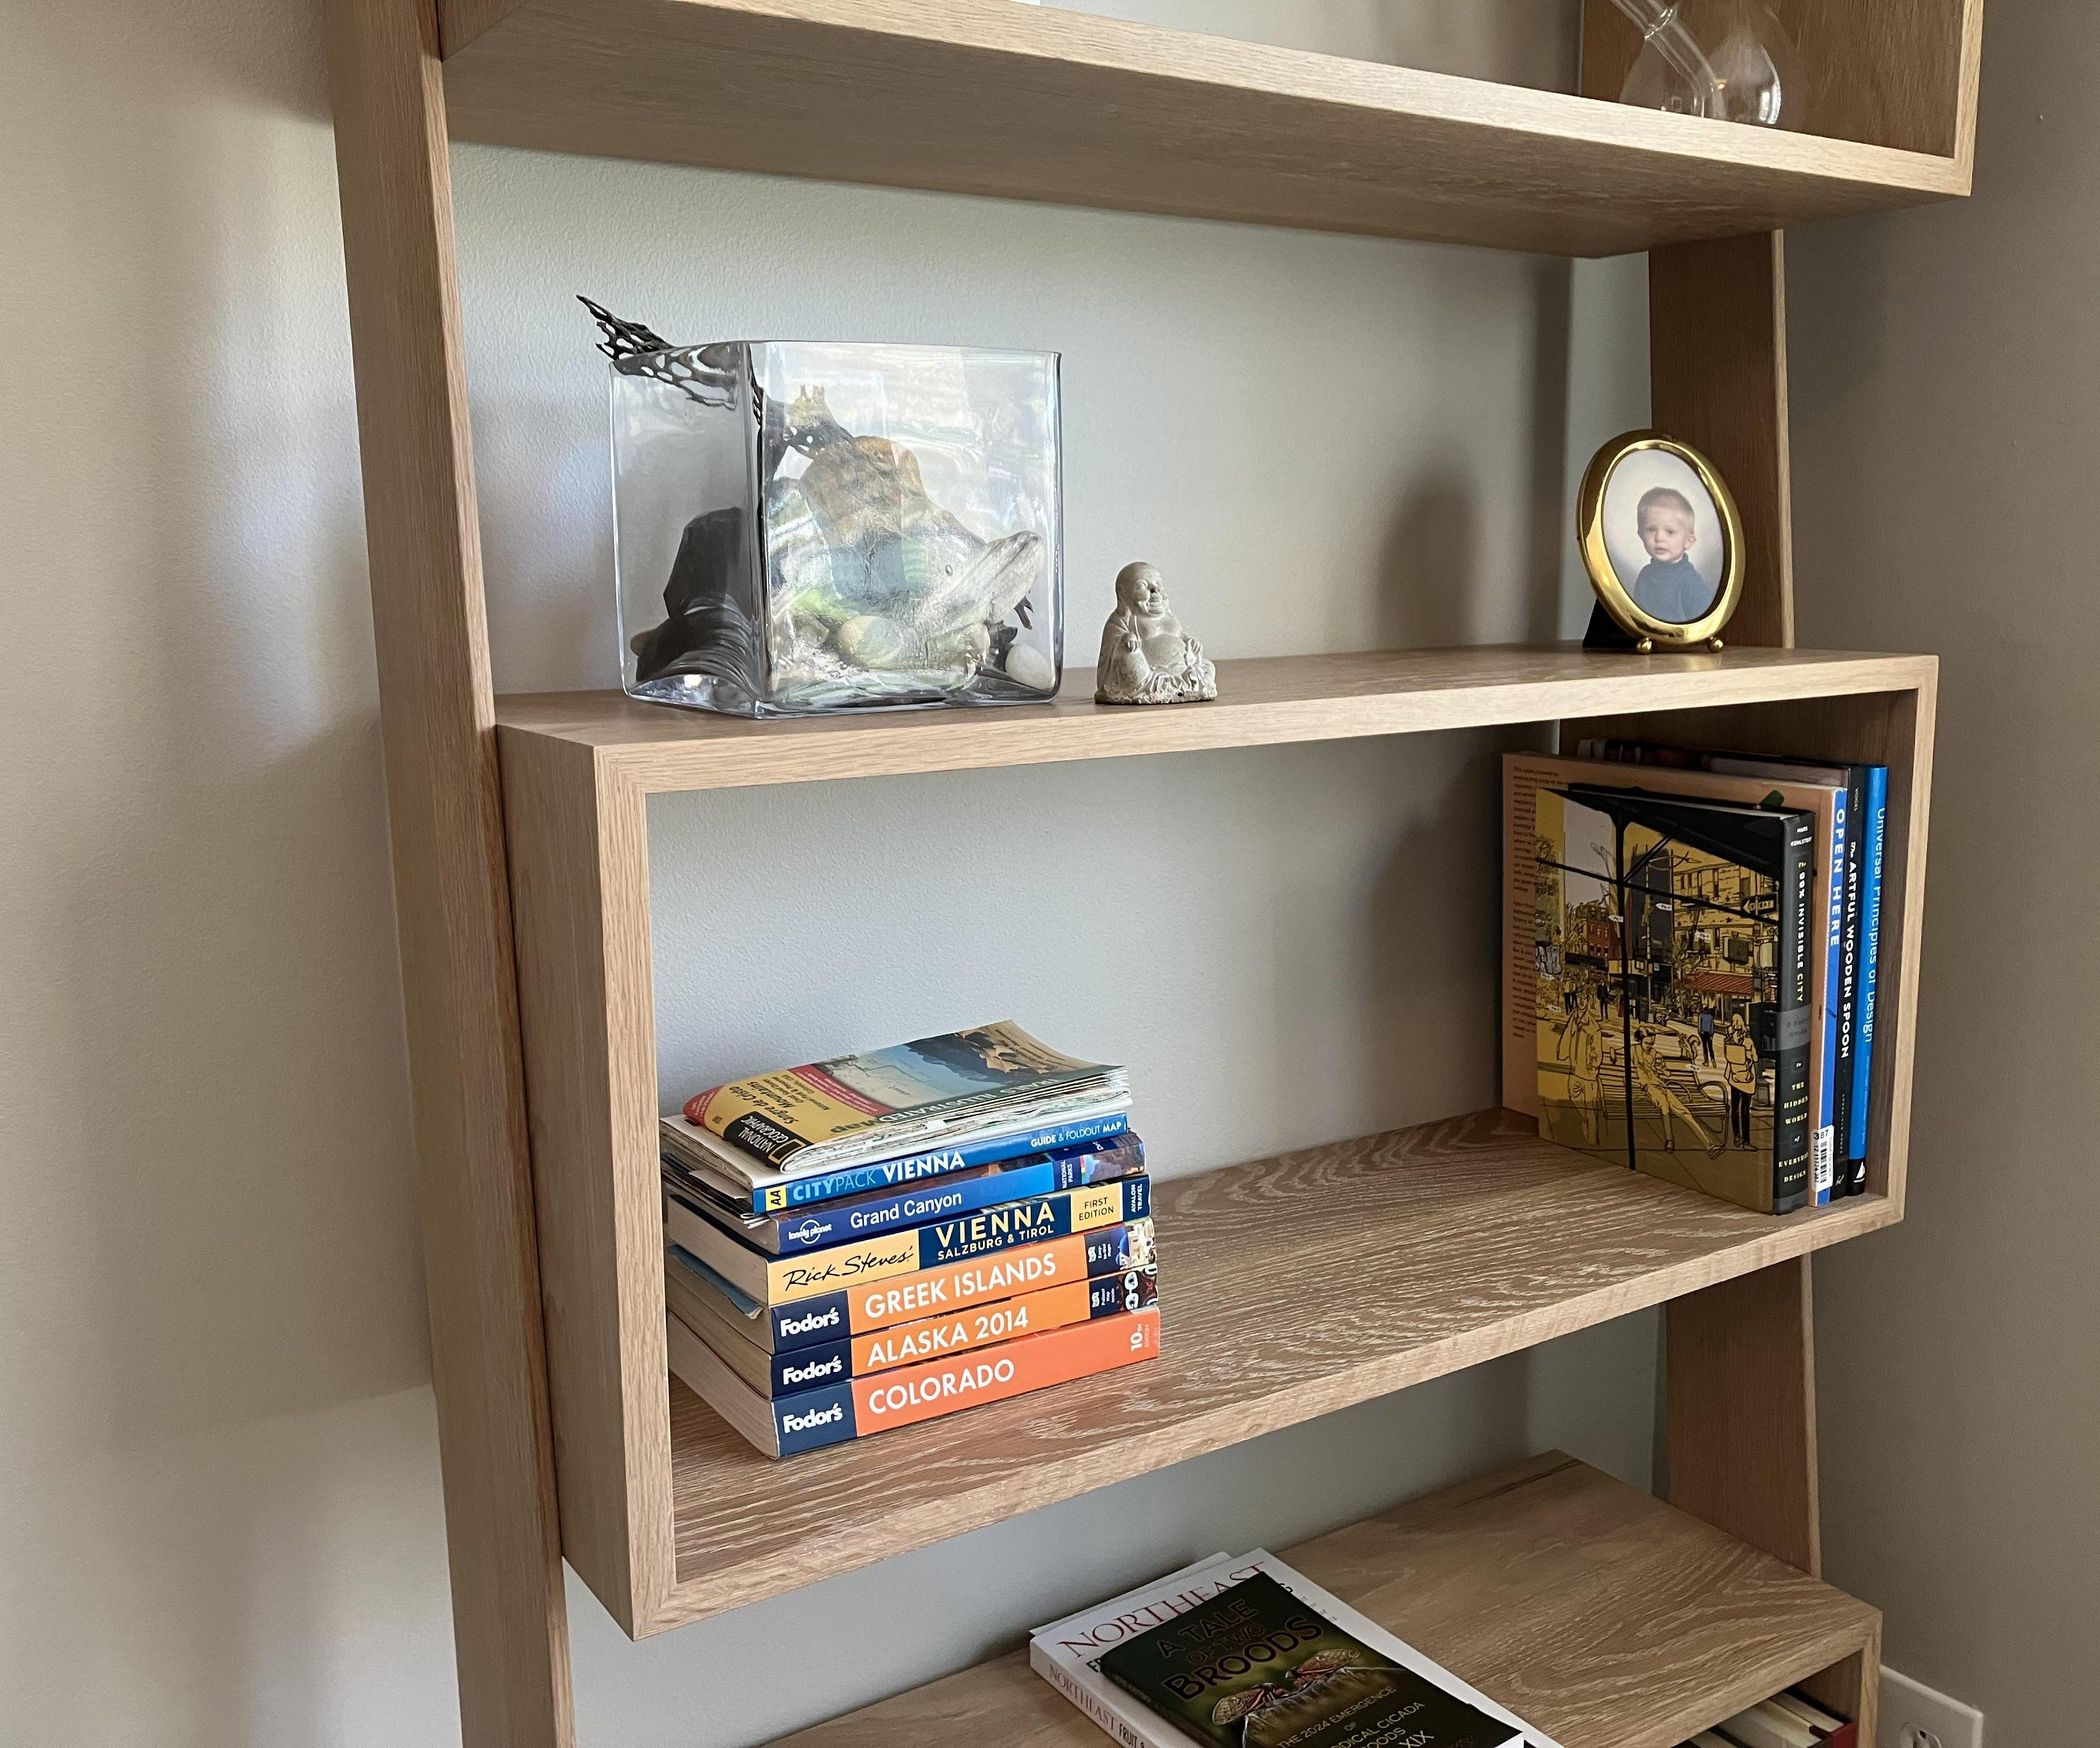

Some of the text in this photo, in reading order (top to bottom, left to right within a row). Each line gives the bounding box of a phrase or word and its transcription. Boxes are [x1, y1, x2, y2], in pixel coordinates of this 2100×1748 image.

[1874, 808, 1885, 879] Universal
[1830, 808, 1845, 946] OPEN HERE
[1847, 861, 1857, 922] ARTFUL
[1796, 902, 1805, 969] INVISIBLE
[1869, 886, 1881, 964] Principles
[1843, 924, 1854, 998] WOODEN
[1841, 1002, 1851, 1058] SPOON
[1862, 991, 1875, 1043] Design
[747, 1081, 796, 1108] Mountains
[879, 1092, 999, 1123] ILLUSTRATED
[1791, 1081, 1805, 1091] THE
[740, 1115, 789, 1144] GEOGRAPHIC
[765, 1105, 799, 1124] Sangre
[738, 1127, 775, 1153] NATIONAL
[770, 1121, 1121, 1206] AA CITYPACK VIENNA GUIDE & FOLDOUT MAP
[850, 1193, 962, 1229] Grand Canyon
[935, 1201, 1055, 1248] VIENNA
[1078, 1206, 1114, 1221] EDITION
[1084, 1196, 1108, 1209] FIRST
[788, 1222, 833, 1241] lonely planet
[937, 1224, 1055, 1261] SALZBURG & TIROL
[783, 1264, 840, 1291] Rick
[865, 1278, 947, 1318] GREEK
[953, 1253, 1056, 1297] ISLANDS
[780, 1307, 840, 1337] Fodor's
[867, 1306, 1029, 1367] ALASKA 2014
[783, 1355, 842, 1385] Fodor's
[869, 1358, 1015, 1414] COLORADO
[782, 1403, 843, 1434] Fodor's
[1056, 1561, 1264, 1658] NORTHEAST
[1157, 1599, 1260, 1658] A TALE
[1161, 1615, 1323, 1700] BROODS
[1187, 1621, 1265, 1665] OF TWO
[1049, 1663, 1114, 1731] NORTHEAST
[1277, 1686, 1397, 1748] THE 2024 EMERGENCE
[1376, 1701, 1426, 1729] CICADA
[1343, 1720, 1358, 1732] OF
